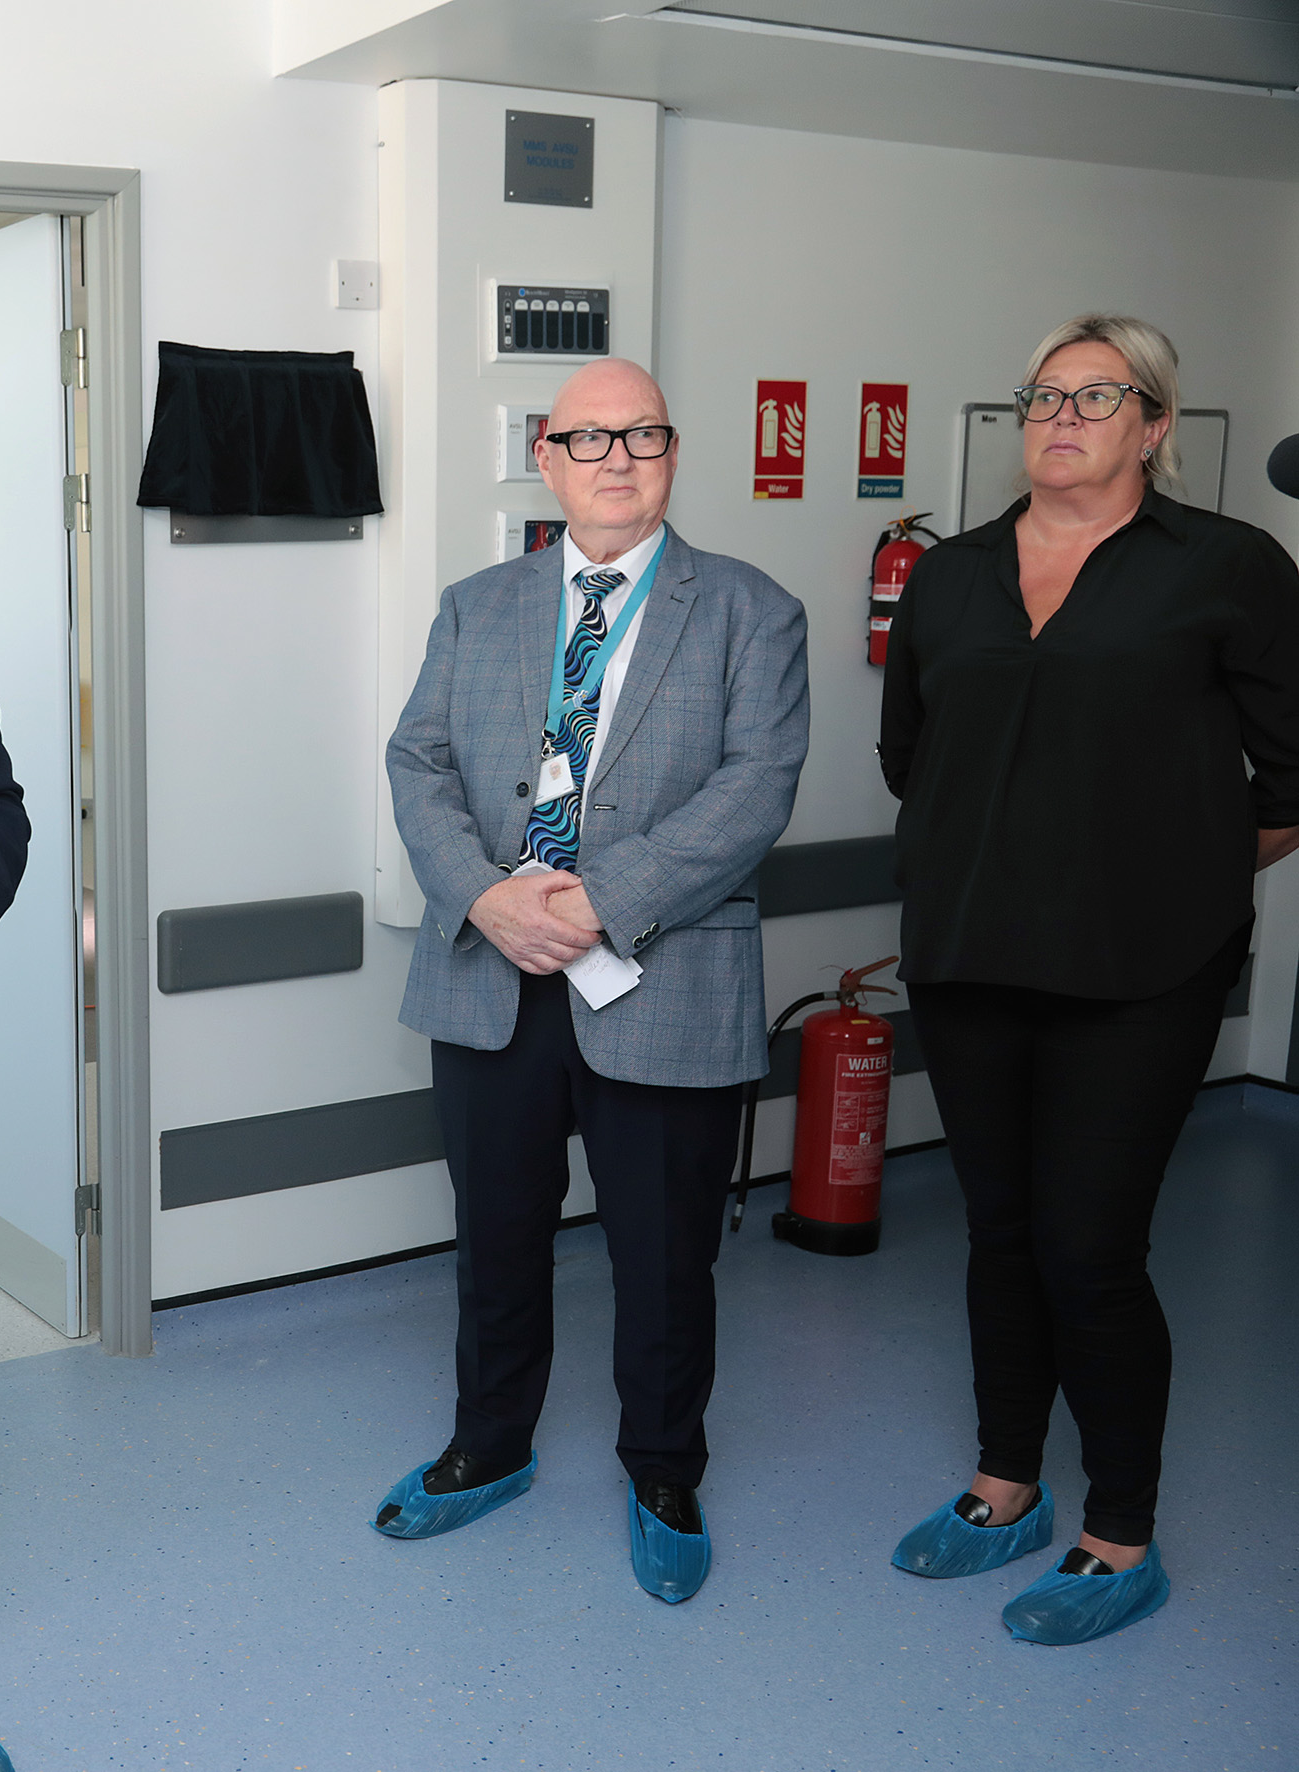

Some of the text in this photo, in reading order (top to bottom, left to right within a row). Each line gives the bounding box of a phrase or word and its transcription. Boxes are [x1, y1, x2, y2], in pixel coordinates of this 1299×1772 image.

[526, 155, 574, 169] MODULES
[982, 414, 998, 424] Mon
[767, 484, 789, 494] Water
[861, 484, 900, 495] Dry powder
[848, 1056, 888, 1071] WATER
